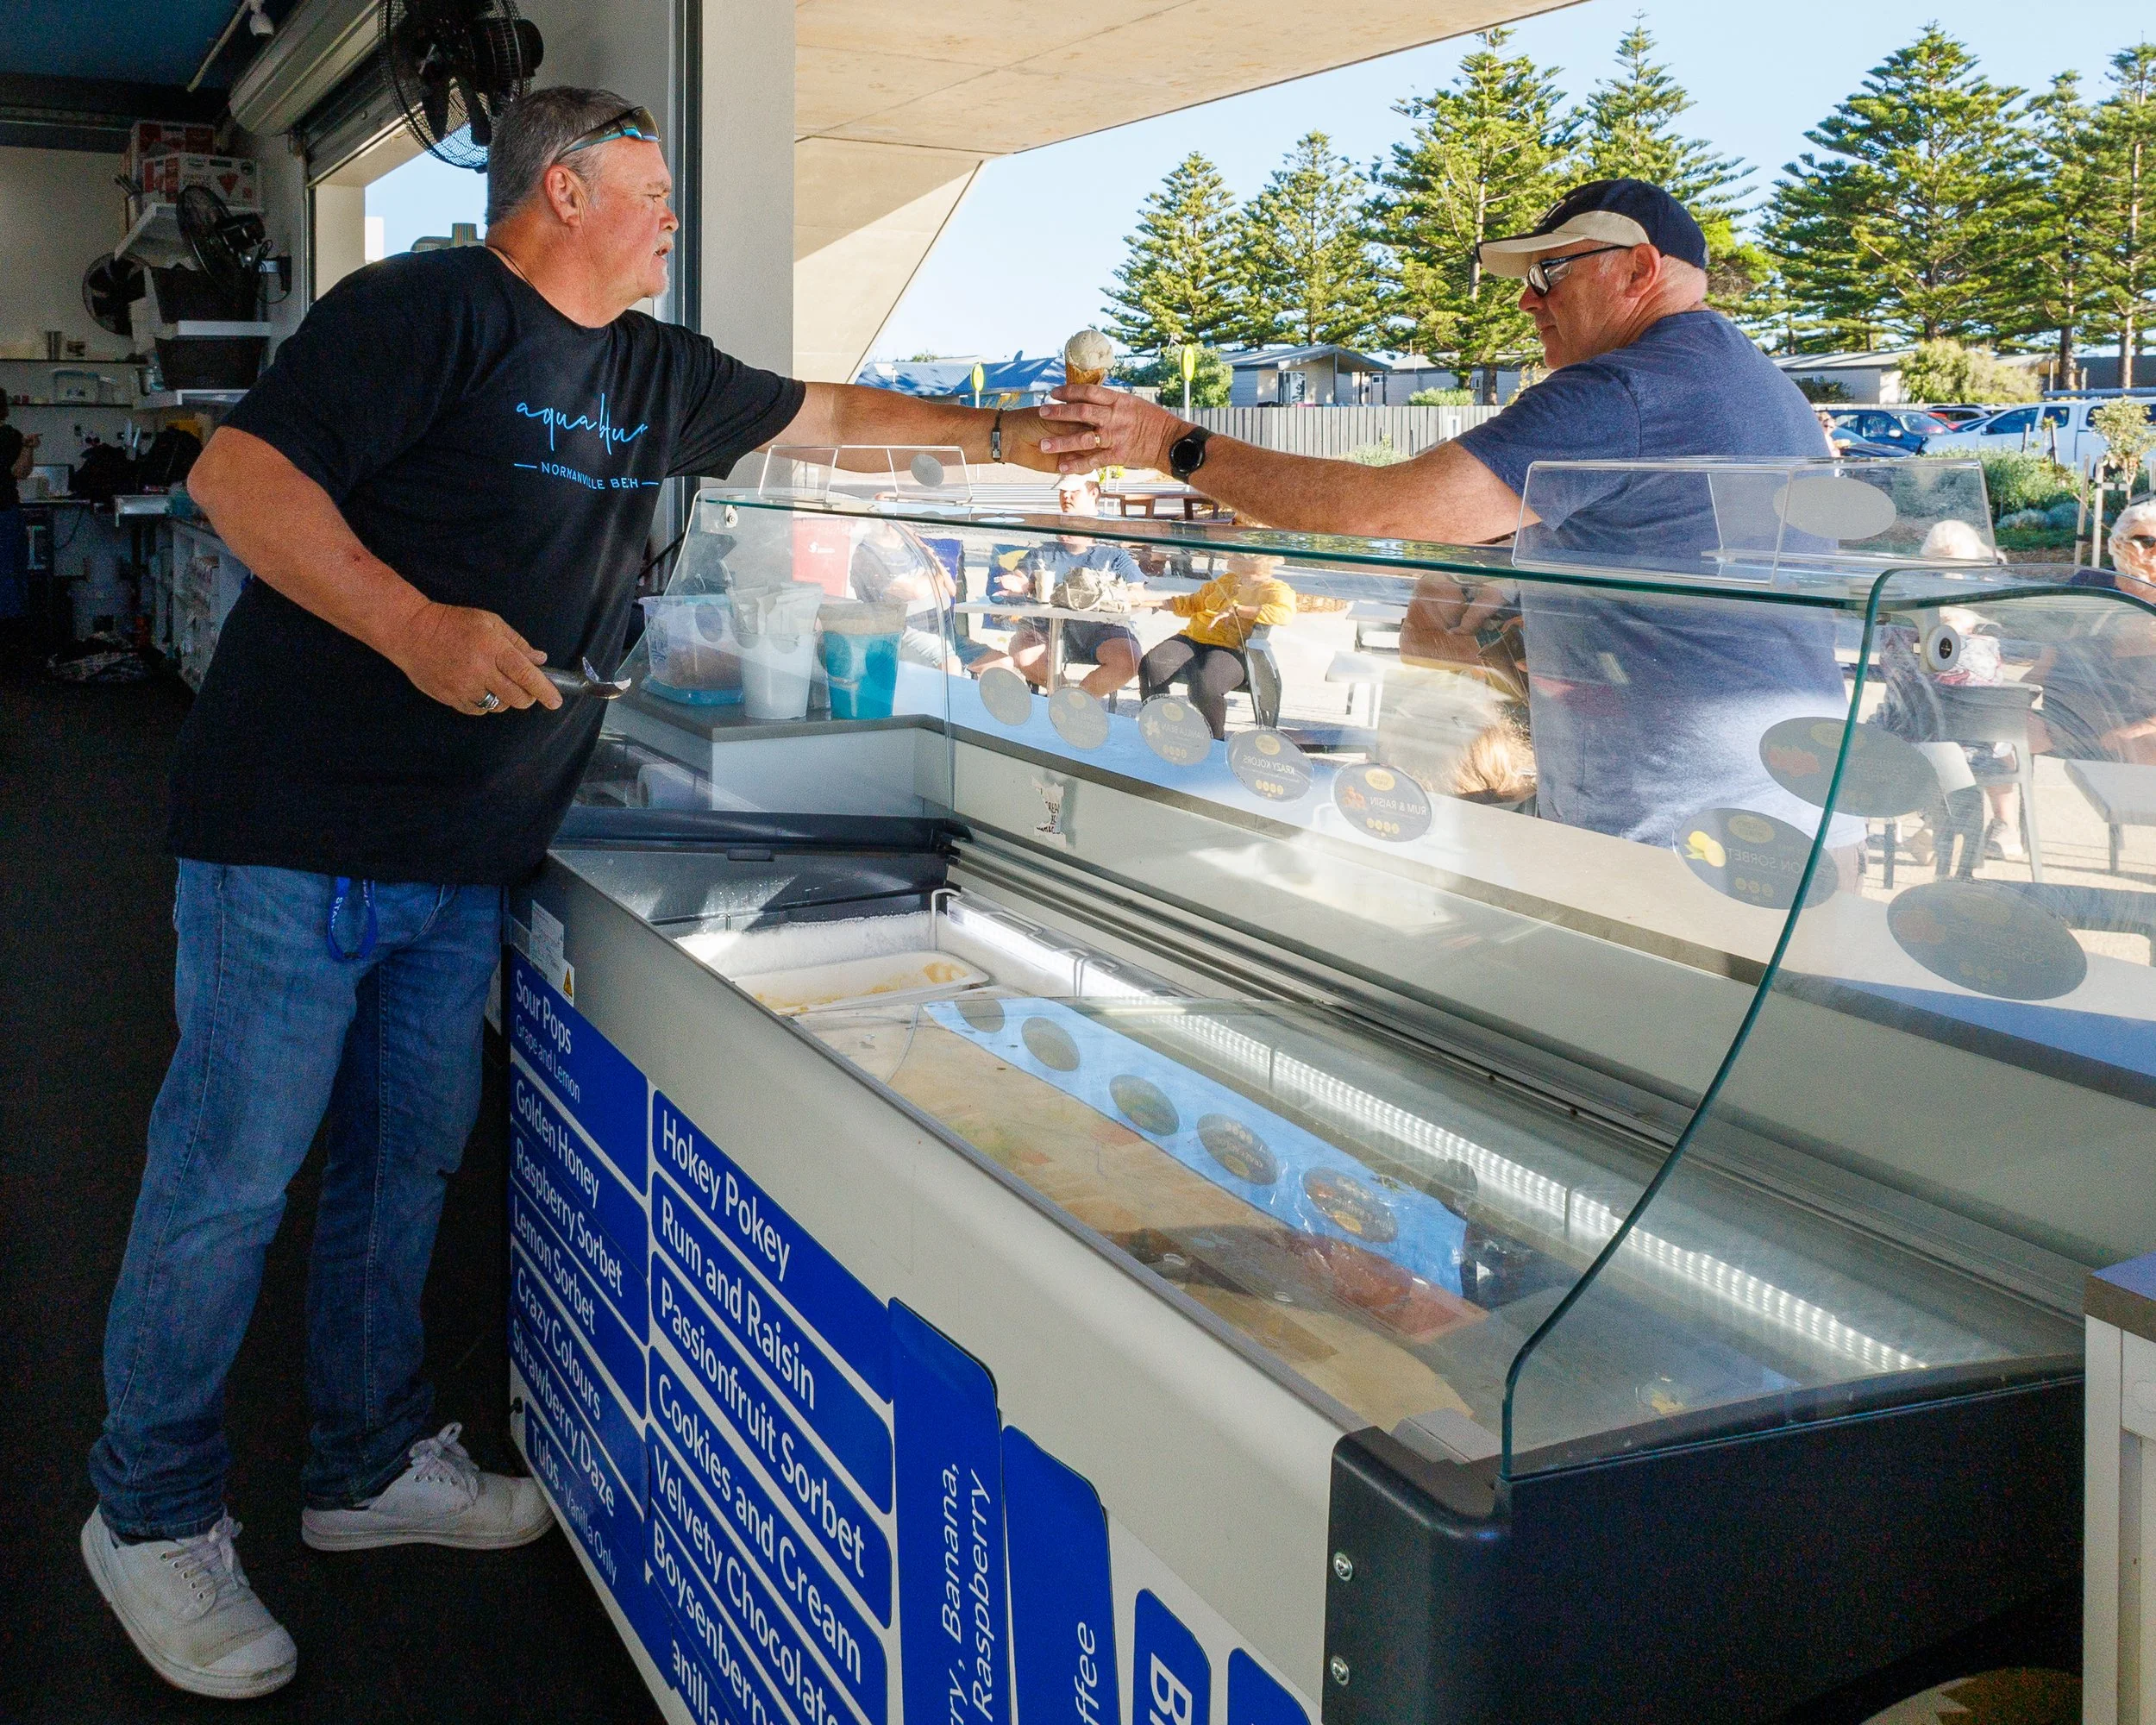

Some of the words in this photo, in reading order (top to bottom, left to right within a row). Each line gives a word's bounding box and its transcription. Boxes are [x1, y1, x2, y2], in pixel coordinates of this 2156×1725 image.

[541, 461, 605, 489] NORMANVILLE
[517, 969, 541, 1021] Sour
[543, 996, 571, 1054] Pops
[517, 1014, 537, 1054] Grape
[538, 1044, 552, 1072] and
[554, 1053, 580, 1103] Lemon
[517, 1079, 555, 1152] Golden
[558, 1125, 599, 1208] Honey
[517, 1137, 574, 1241] Raspberry
[578, 1211, 622, 1297] Sorbet
[662, 1109, 721, 1211] Hokey
[725, 1170, 790, 1283] Pokey
[515, 1195, 551, 1273] Lemon
[554, 1248, 595, 1335] Sorbet
[517, 1267, 550, 1344] Crazy
[552, 1320, 600, 1421] Colours
[662, 1194, 702, 1278] Rum
[705, 1258, 742, 1325] and
[747, 1289, 814, 1411] Raisin
[513, 1319, 578, 1457] Strawberry
[580, 1429, 614, 1517] Daze
[661, 1276, 776, 1464] Passionfruit
[781, 1432, 865, 1578] Sorbet
[531, 1419, 559, 1490] Tubs
[565, 1483, 593, 1545] Vanilla
[594, 1530, 617, 1586] Only
[655, 1445, 723, 1584] Velvety
[659, 1374, 731, 1502] Cookies
[736, 1485, 774, 1565] and
[780, 1536, 862, 1684] Cream
[943, 1464, 962, 1645] Banana,
[968, 1468, 994, 1722] Raspberry
[1075, 1622, 1100, 1725] ffee
